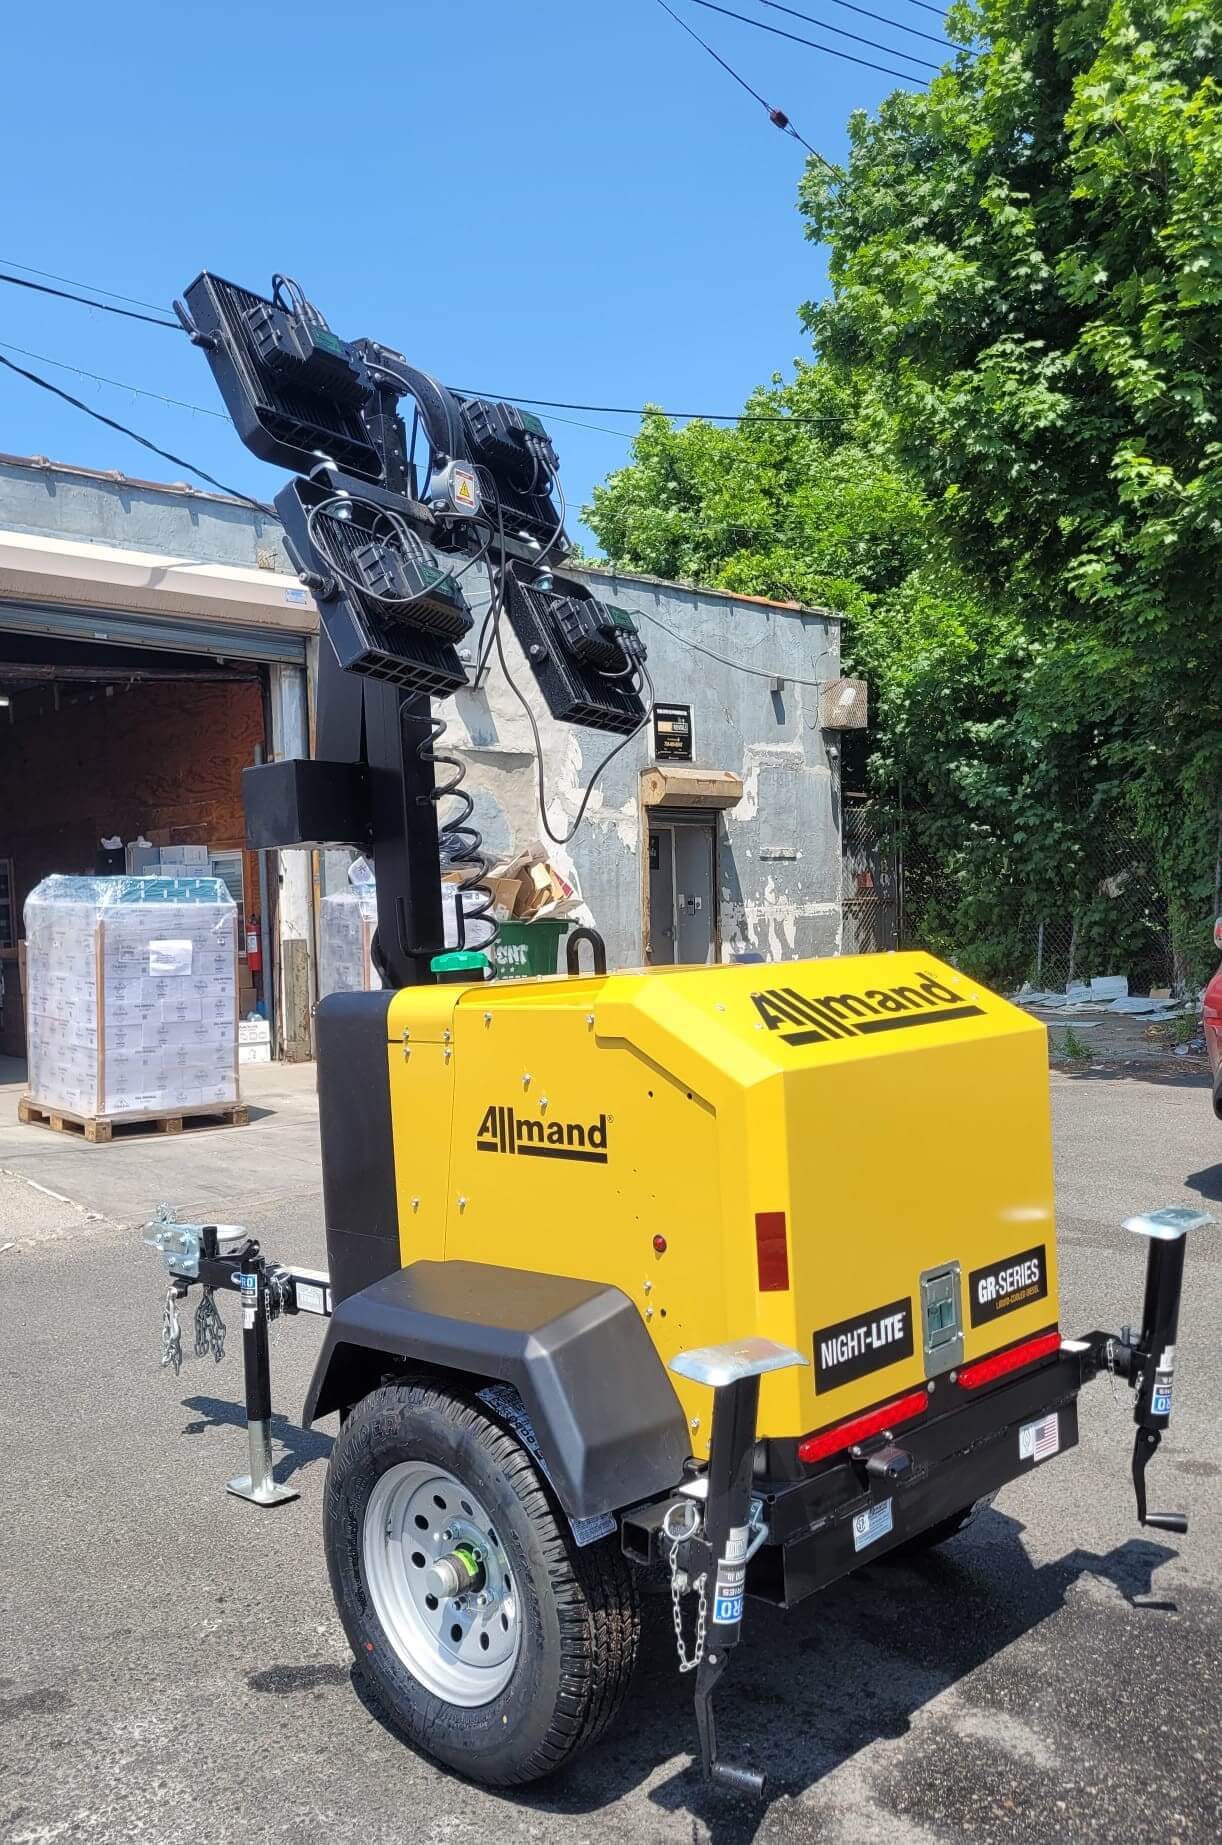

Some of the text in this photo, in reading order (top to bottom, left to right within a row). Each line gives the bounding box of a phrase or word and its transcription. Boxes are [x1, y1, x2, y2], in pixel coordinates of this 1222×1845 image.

[751, 972, 967, 1040] Allmand
[477, 1105, 607, 1155] Allmand
[978, 1258, 1040, 1305] GR-SERIES
[820, 1312, 904, 1370] NIGHT-LITE
